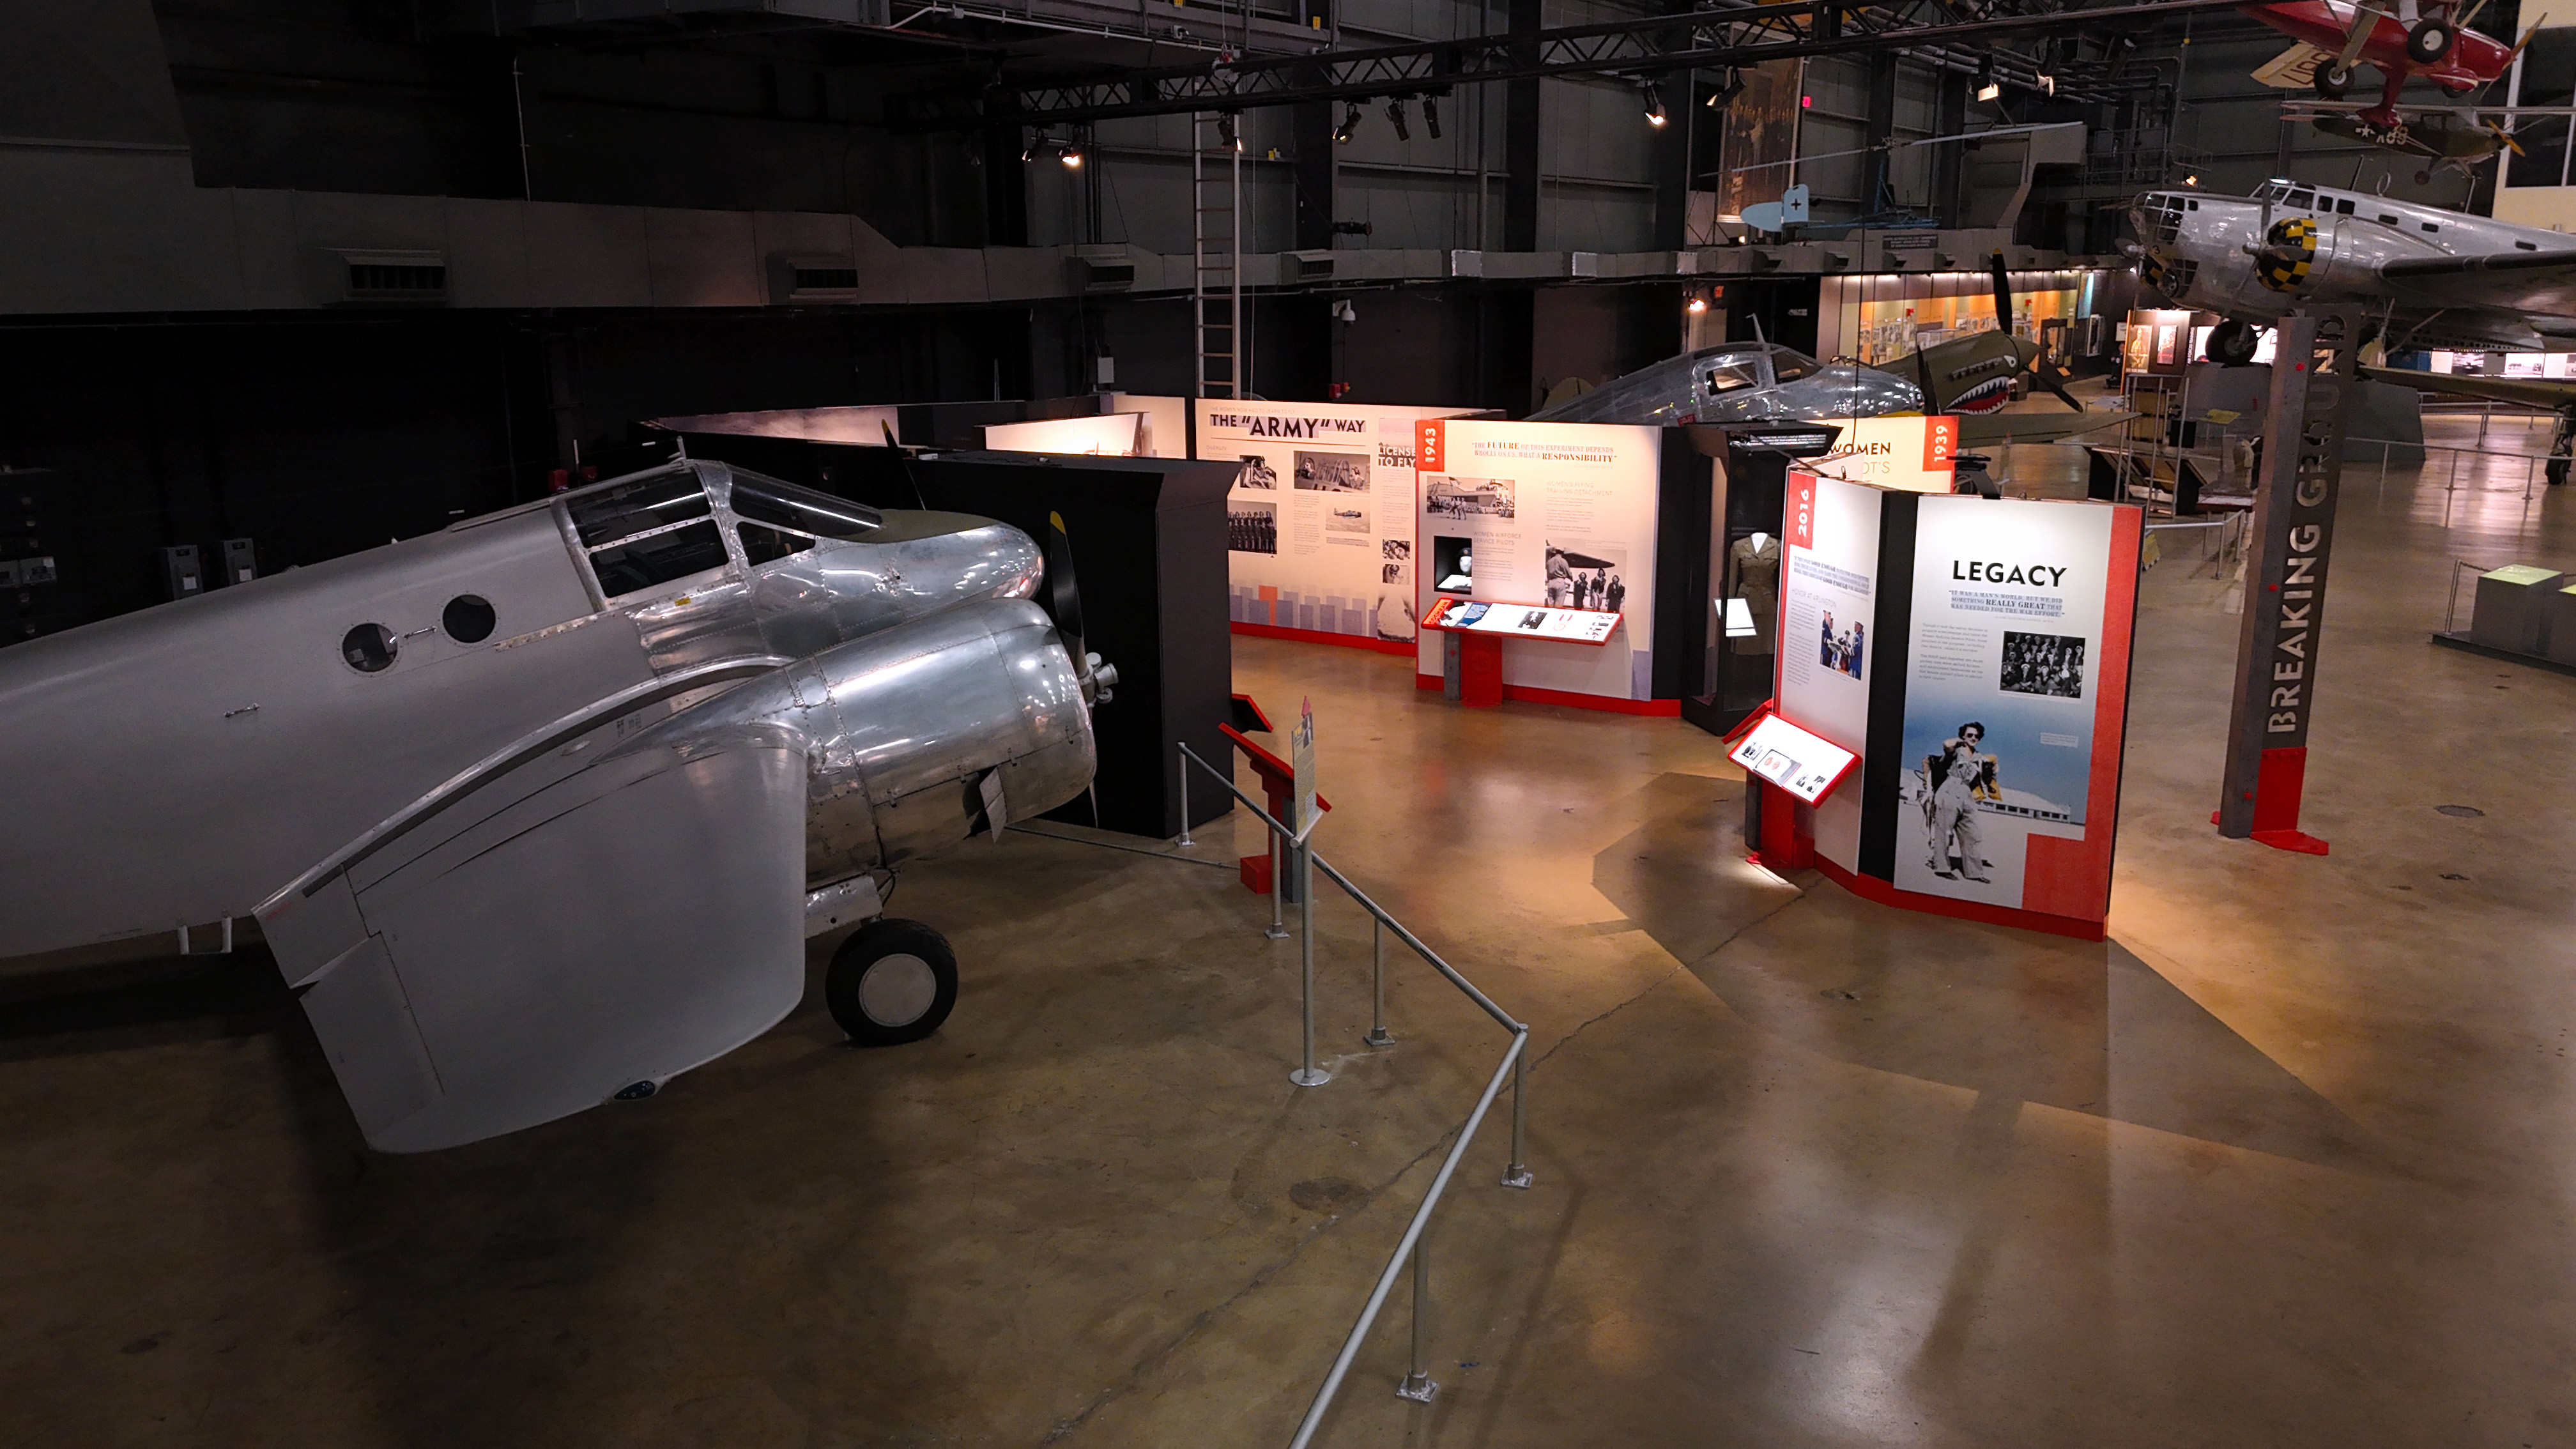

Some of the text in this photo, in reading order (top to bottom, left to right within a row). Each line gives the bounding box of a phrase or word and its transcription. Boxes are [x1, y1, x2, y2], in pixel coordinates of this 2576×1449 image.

[1210, 414, 1365, 438] THE "ARMY" WAY
[1379, 446, 1416, 457] LICENSE
[1425, 428, 1436, 462] 1943
[1830, 442, 1891, 455] WOMEN
[1934, 425, 1948, 462] 1939
[1379, 457, 1416, 468] TO FLY
[1863, 461, 1890, 475] OT'S
[1798, 489, 1809, 537] 2016
[2267, 314, 2347, 733] BREAKING GROUND
[1952, 560, 2067, 587] LEGACY
[1986, 599, 2016, 607] REALLY
[2018, 601, 2046, 610] GREAT
